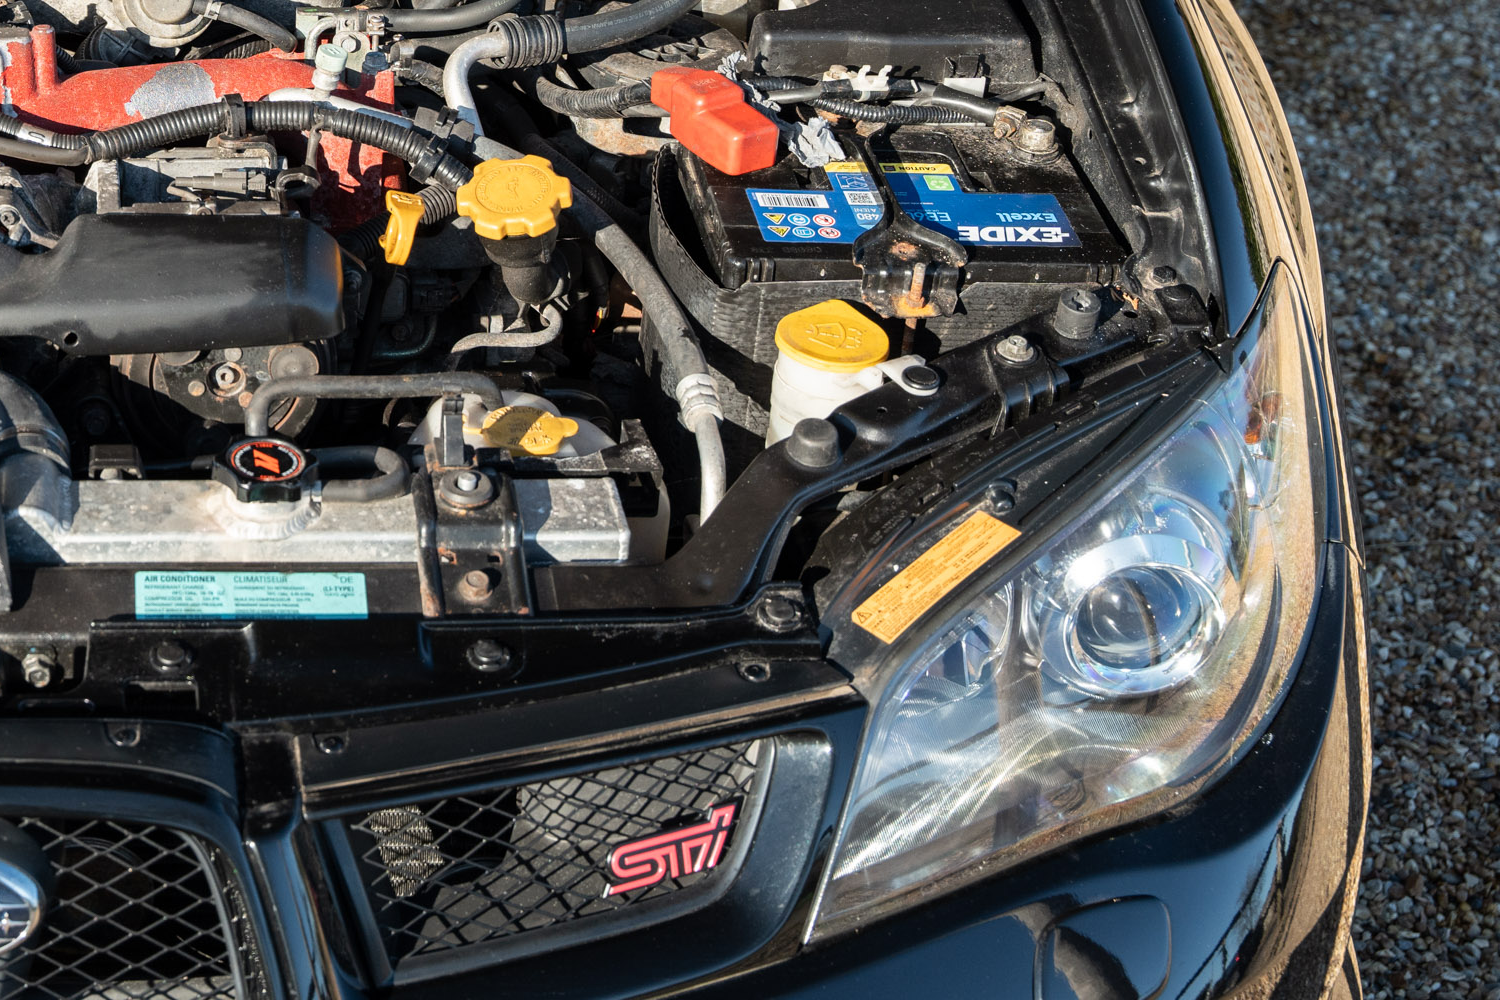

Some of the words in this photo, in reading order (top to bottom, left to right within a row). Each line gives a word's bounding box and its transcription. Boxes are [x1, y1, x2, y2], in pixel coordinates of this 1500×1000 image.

[856, 212, 879, 221] 480
[995, 212, 1058, 223] Excell
[957, 225, 1070, 243] EXIDE
[233, 575, 288, 583] CLIMATISEUR
